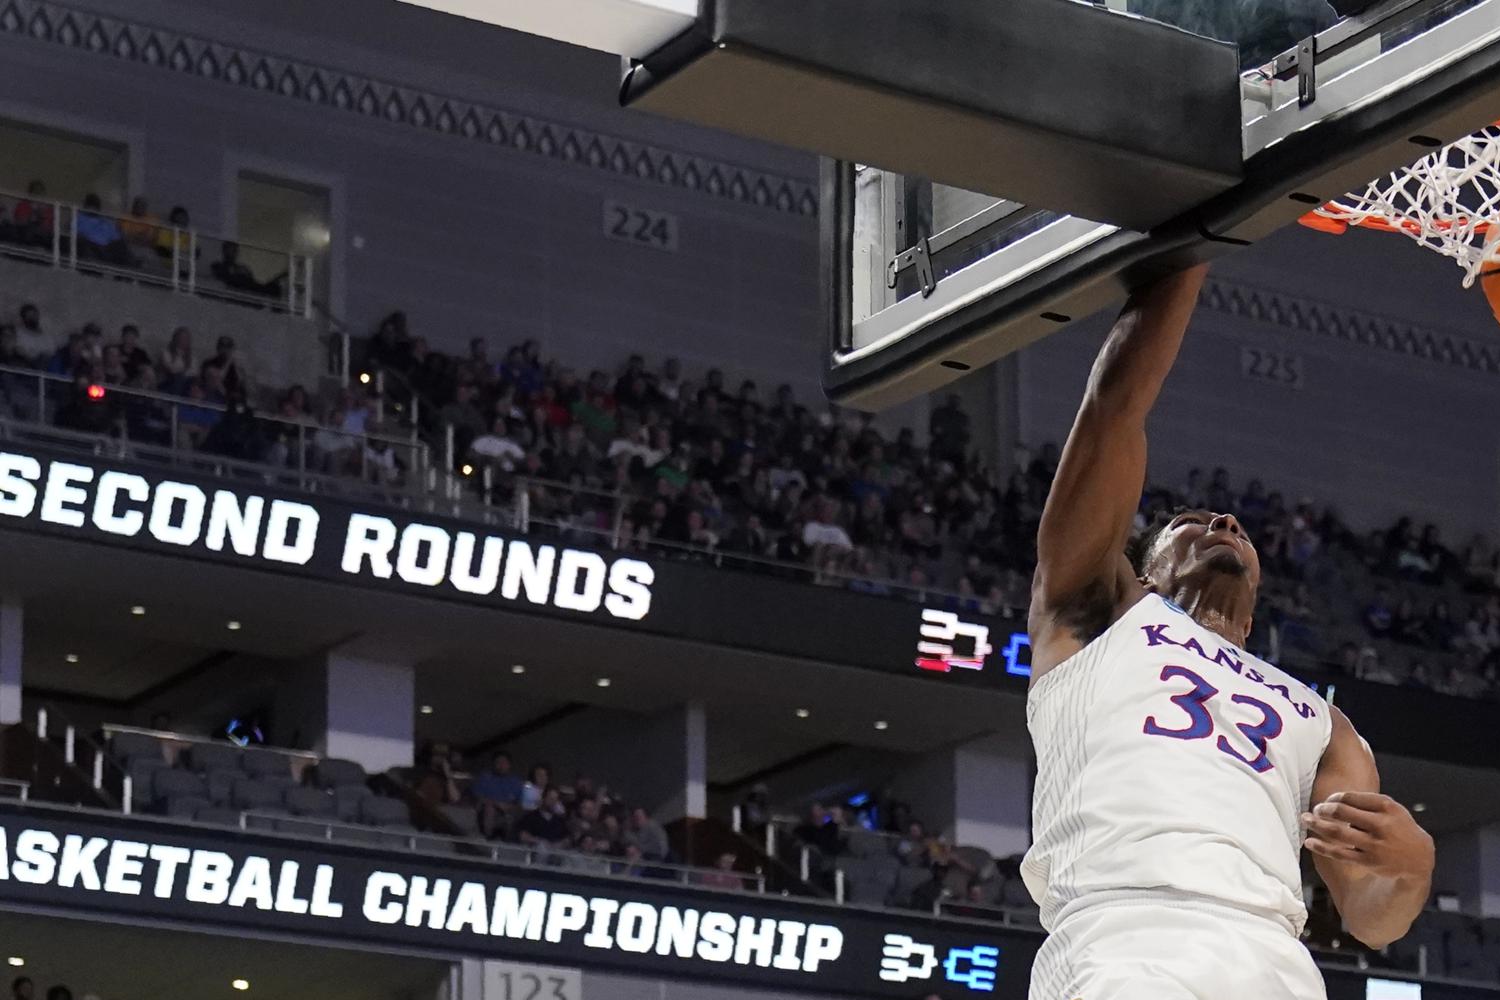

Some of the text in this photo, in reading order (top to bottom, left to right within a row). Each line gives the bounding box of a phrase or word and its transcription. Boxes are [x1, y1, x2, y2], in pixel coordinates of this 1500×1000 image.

[612, 206, 668, 244] 224
[0, 453, 654, 619] SECOND ROUNDS
[1140, 624, 1316, 719] KANSAS
[1143, 665, 1284, 773] 33
[0, 827, 843, 972] SKETBALL CHAMPIONSHIP
